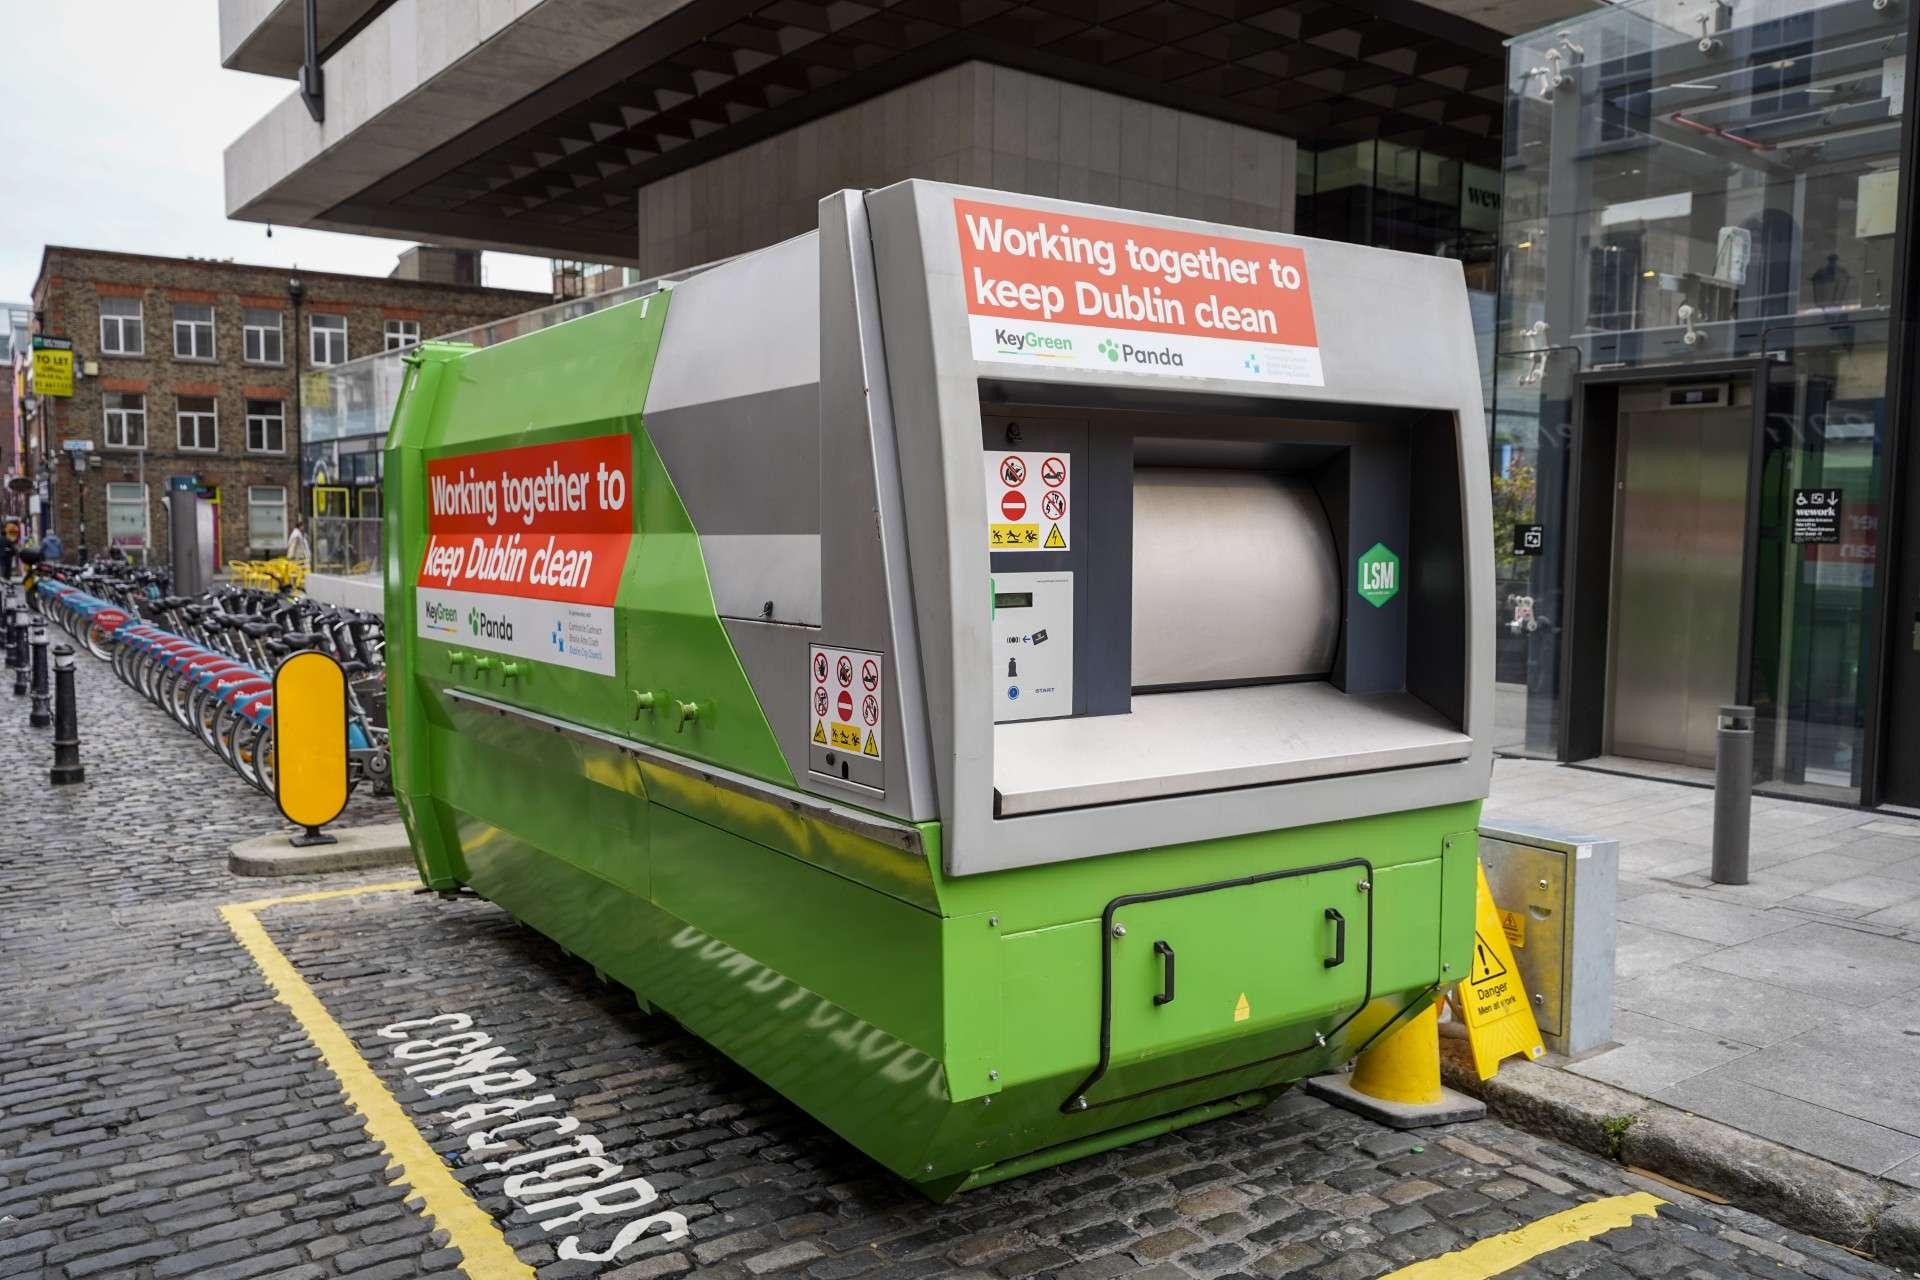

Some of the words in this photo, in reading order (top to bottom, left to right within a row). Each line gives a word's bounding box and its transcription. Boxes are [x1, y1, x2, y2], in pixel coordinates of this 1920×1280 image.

[965, 213, 1115, 276] Working
[1125, 239, 1260, 284] together
[1269, 258, 1301, 290] to
[973, 267, 1064, 319] keep
[1075, 280, 1184, 325] Dublin
[1195, 295, 1277, 334] clean
[995, 329, 1073, 350] KeyGreen
[1122, 344, 1184, 367] Panda
[431, 467, 497, 526] Working
[502, 460, 590, 526] together
[597, 462, 626, 510] to
[1795, 507, 1836, 516] wework
[423, 534, 465, 586] keep
[465, 533, 528, 583] Dublin
[529, 535, 593, 588] clean
[1363, 561, 1394, 589] LSM
[425, 602, 458, 624] KeyGreen
[480, 613, 513, 641] Panda
[1477, 982, 1508, 1000] Danger
[1477, 1003, 1493, 1015] Men
[377, 1012, 690, 1262] COMPACTORS
